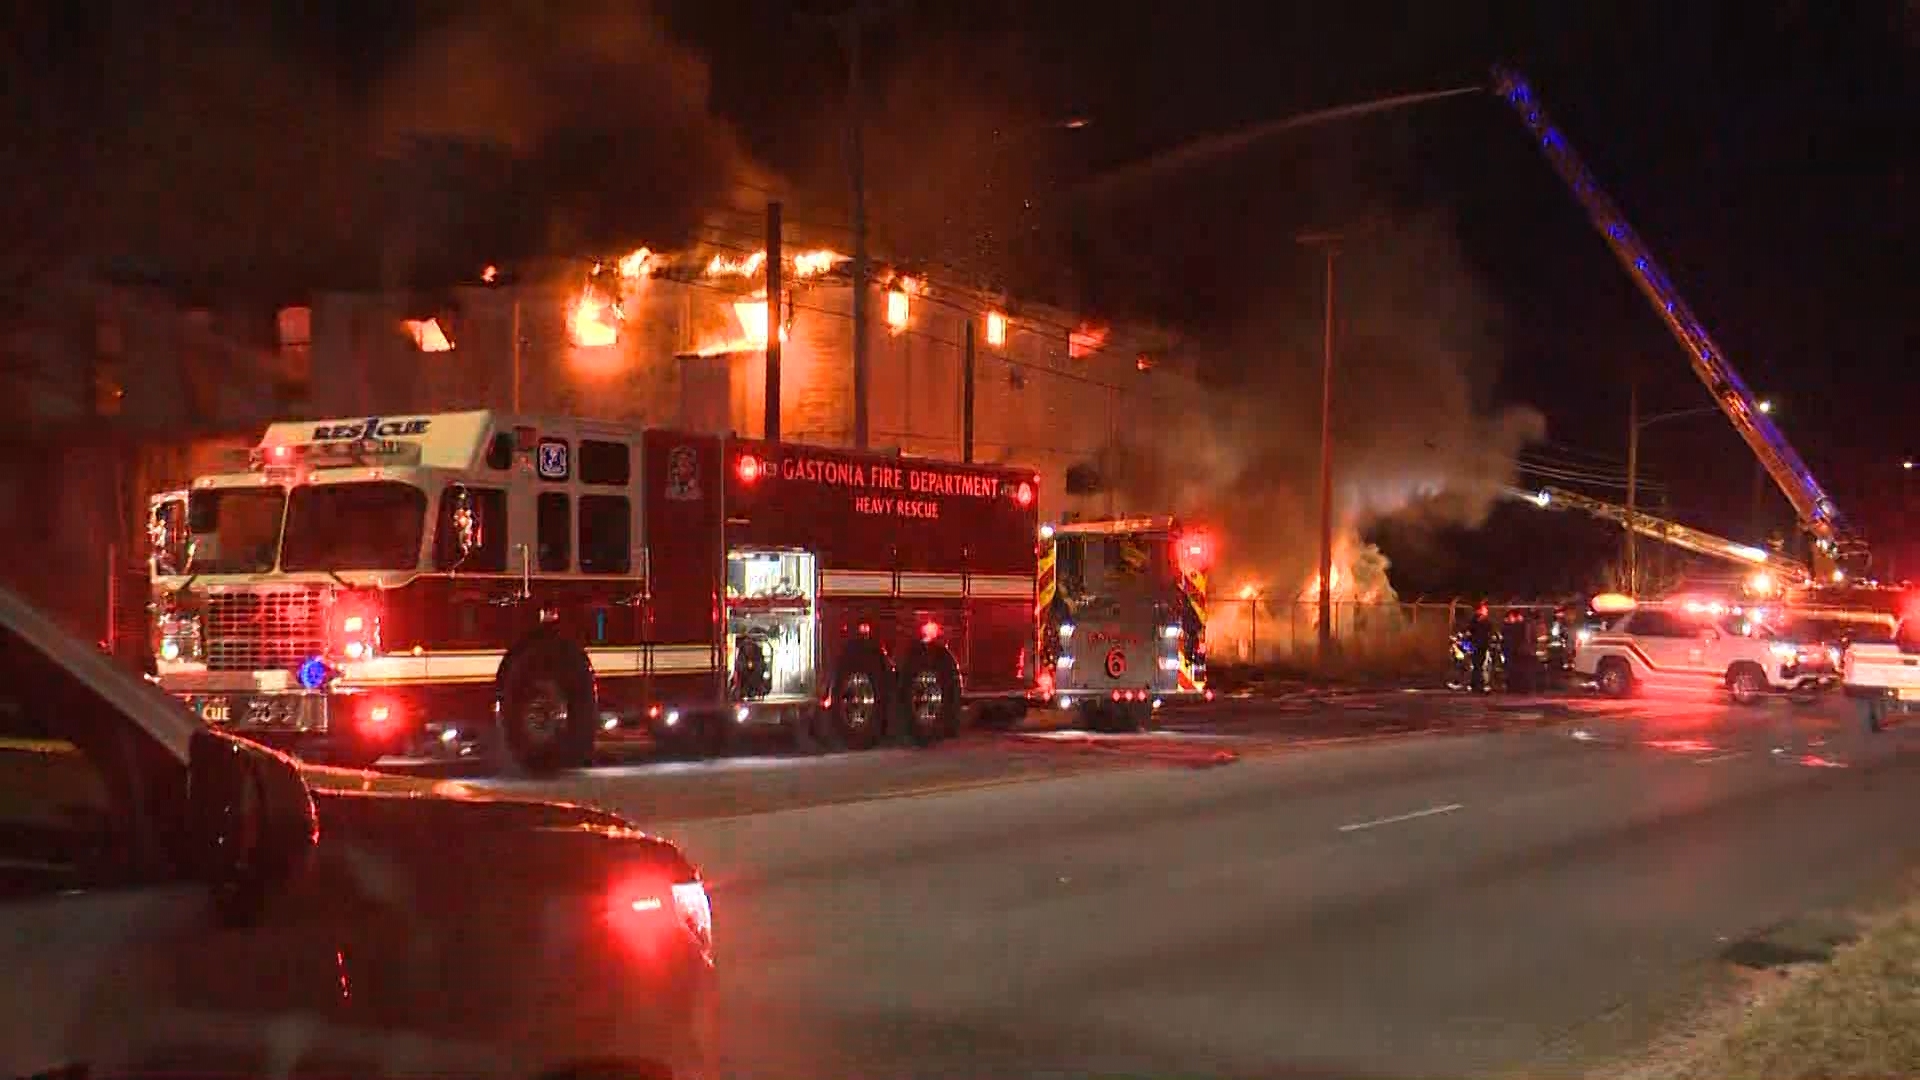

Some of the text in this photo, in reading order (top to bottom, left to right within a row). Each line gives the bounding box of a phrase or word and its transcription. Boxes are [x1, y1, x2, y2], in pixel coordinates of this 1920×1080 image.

[783, 459, 864, 486] GASTONIA
[871, 466, 902, 489] FIRE
[910, 471, 999, 498] DEPARTMENT
[855, 496, 939, 518] HEAVY RESCUE
[1105, 648, 1127, 680] 6
[195, 703, 231, 722] CUE
